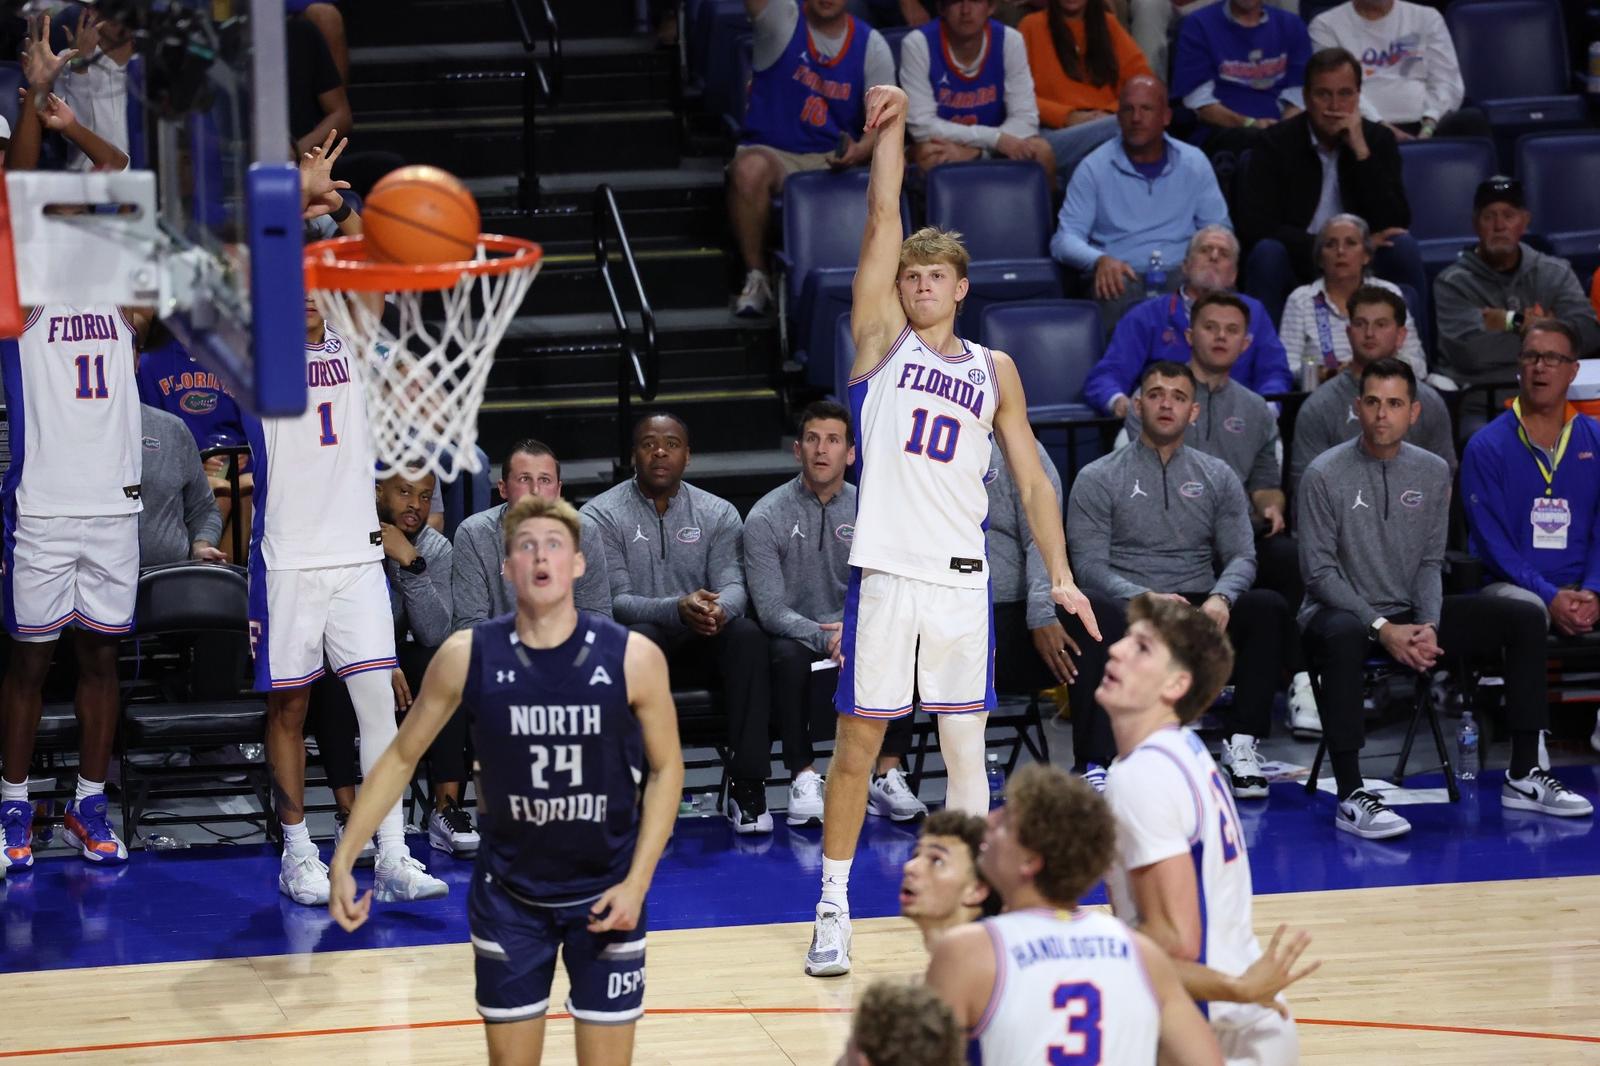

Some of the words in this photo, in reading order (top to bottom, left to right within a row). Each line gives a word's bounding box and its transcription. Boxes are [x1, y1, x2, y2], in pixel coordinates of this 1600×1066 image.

[800, 95, 828, 127] 10
[74, 354, 109, 400] 11
[897, 363, 985, 420] FLORIDA
[969, 371, 985, 383] SEC
[317, 401, 338, 446] 1
[904, 407, 961, 463] 10
[508, 704, 602, 736] NORTH
[529, 744, 583, 789] 24
[508, 792, 608, 827] FLORIDA
[1047, 980, 1102, 1066] 3
